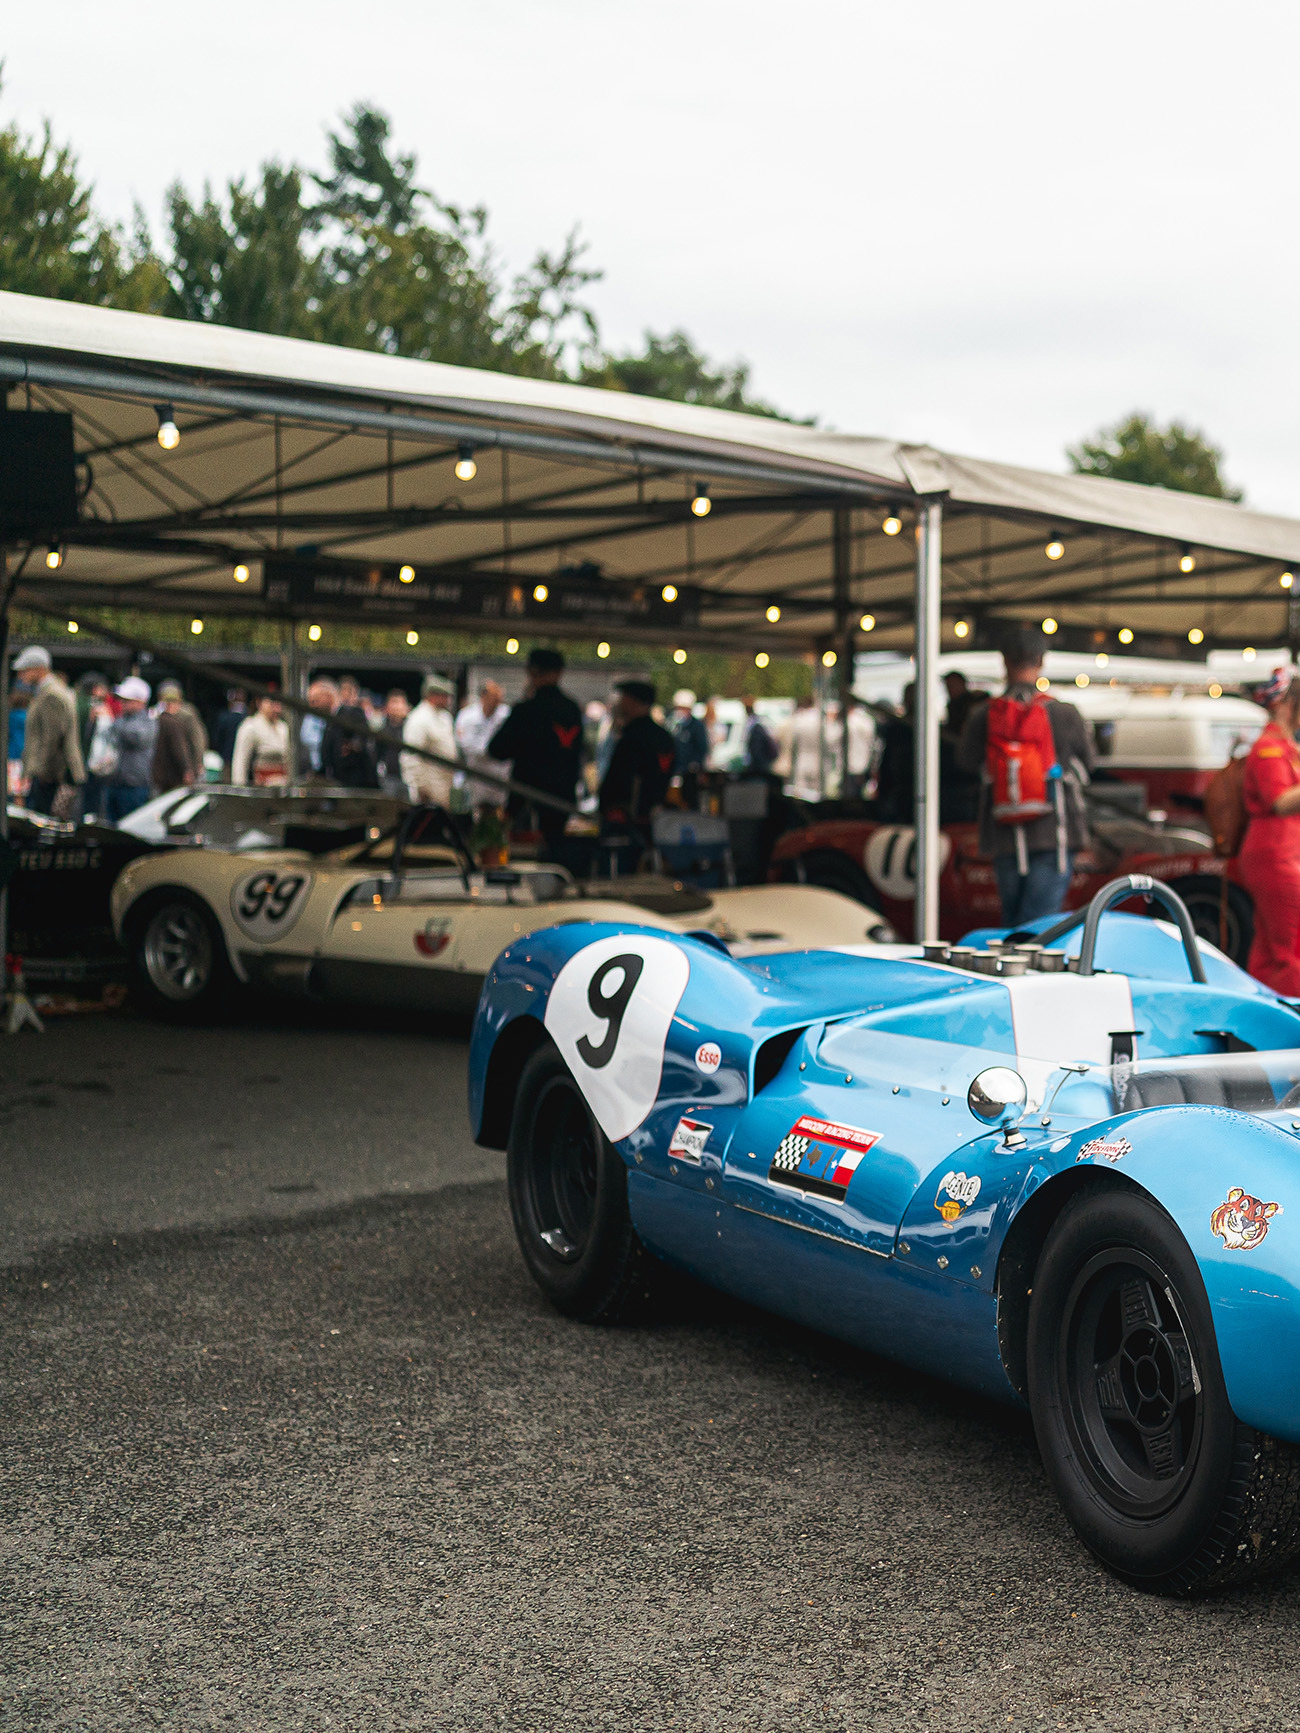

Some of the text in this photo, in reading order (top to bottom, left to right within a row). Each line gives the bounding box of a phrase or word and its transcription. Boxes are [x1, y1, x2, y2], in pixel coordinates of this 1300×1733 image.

[240, 872, 305, 920] 99
[575, 953, 645, 1069] 9
[698, 1047, 719, 1066] Esso
[823, 1124, 854, 1140] RACING
[850, 1131, 876, 1146] TEAM
[947, 1176, 975, 1197] GENIE
